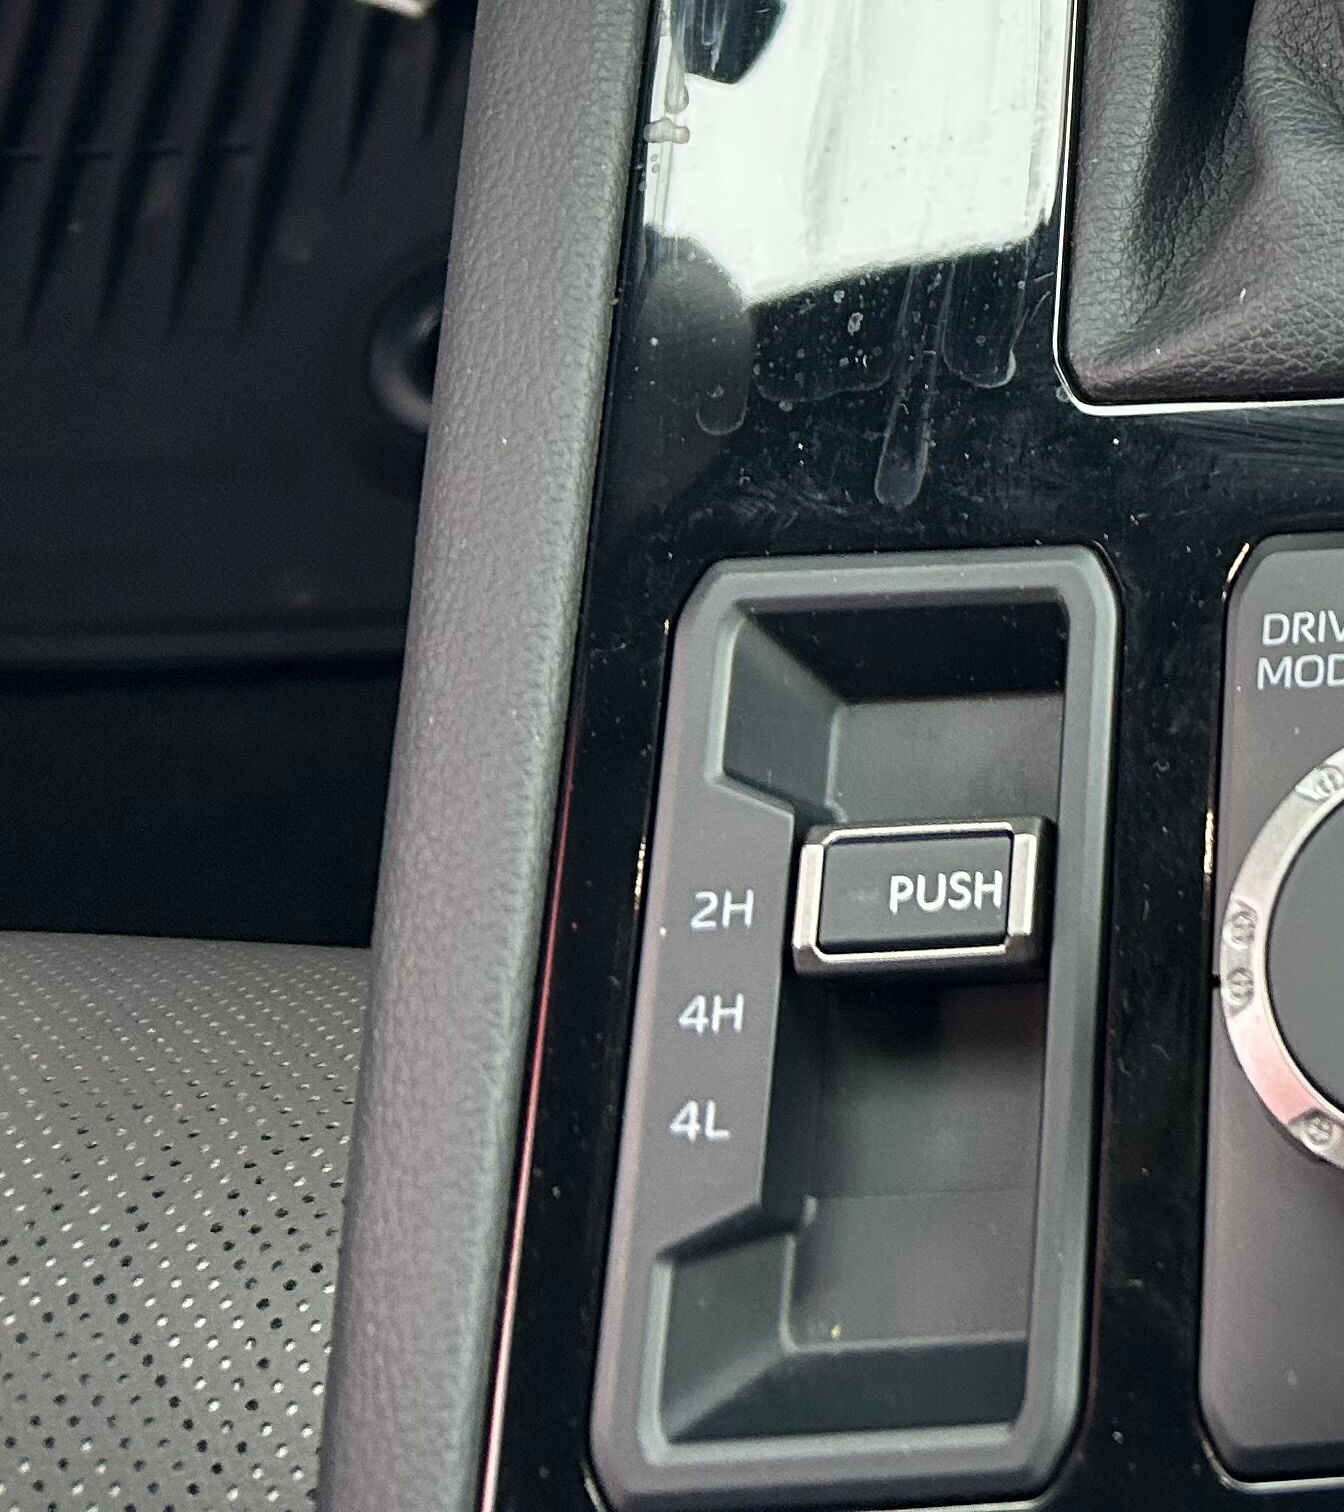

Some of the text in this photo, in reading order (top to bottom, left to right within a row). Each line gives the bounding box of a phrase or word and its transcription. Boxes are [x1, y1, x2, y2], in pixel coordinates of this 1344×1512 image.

[690, 890, 755, 930] 2H
[888, 870, 1004, 915] PUSH
[678, 994, 743, 1033] 4H
[670, 1100, 730, 1140] 4L
